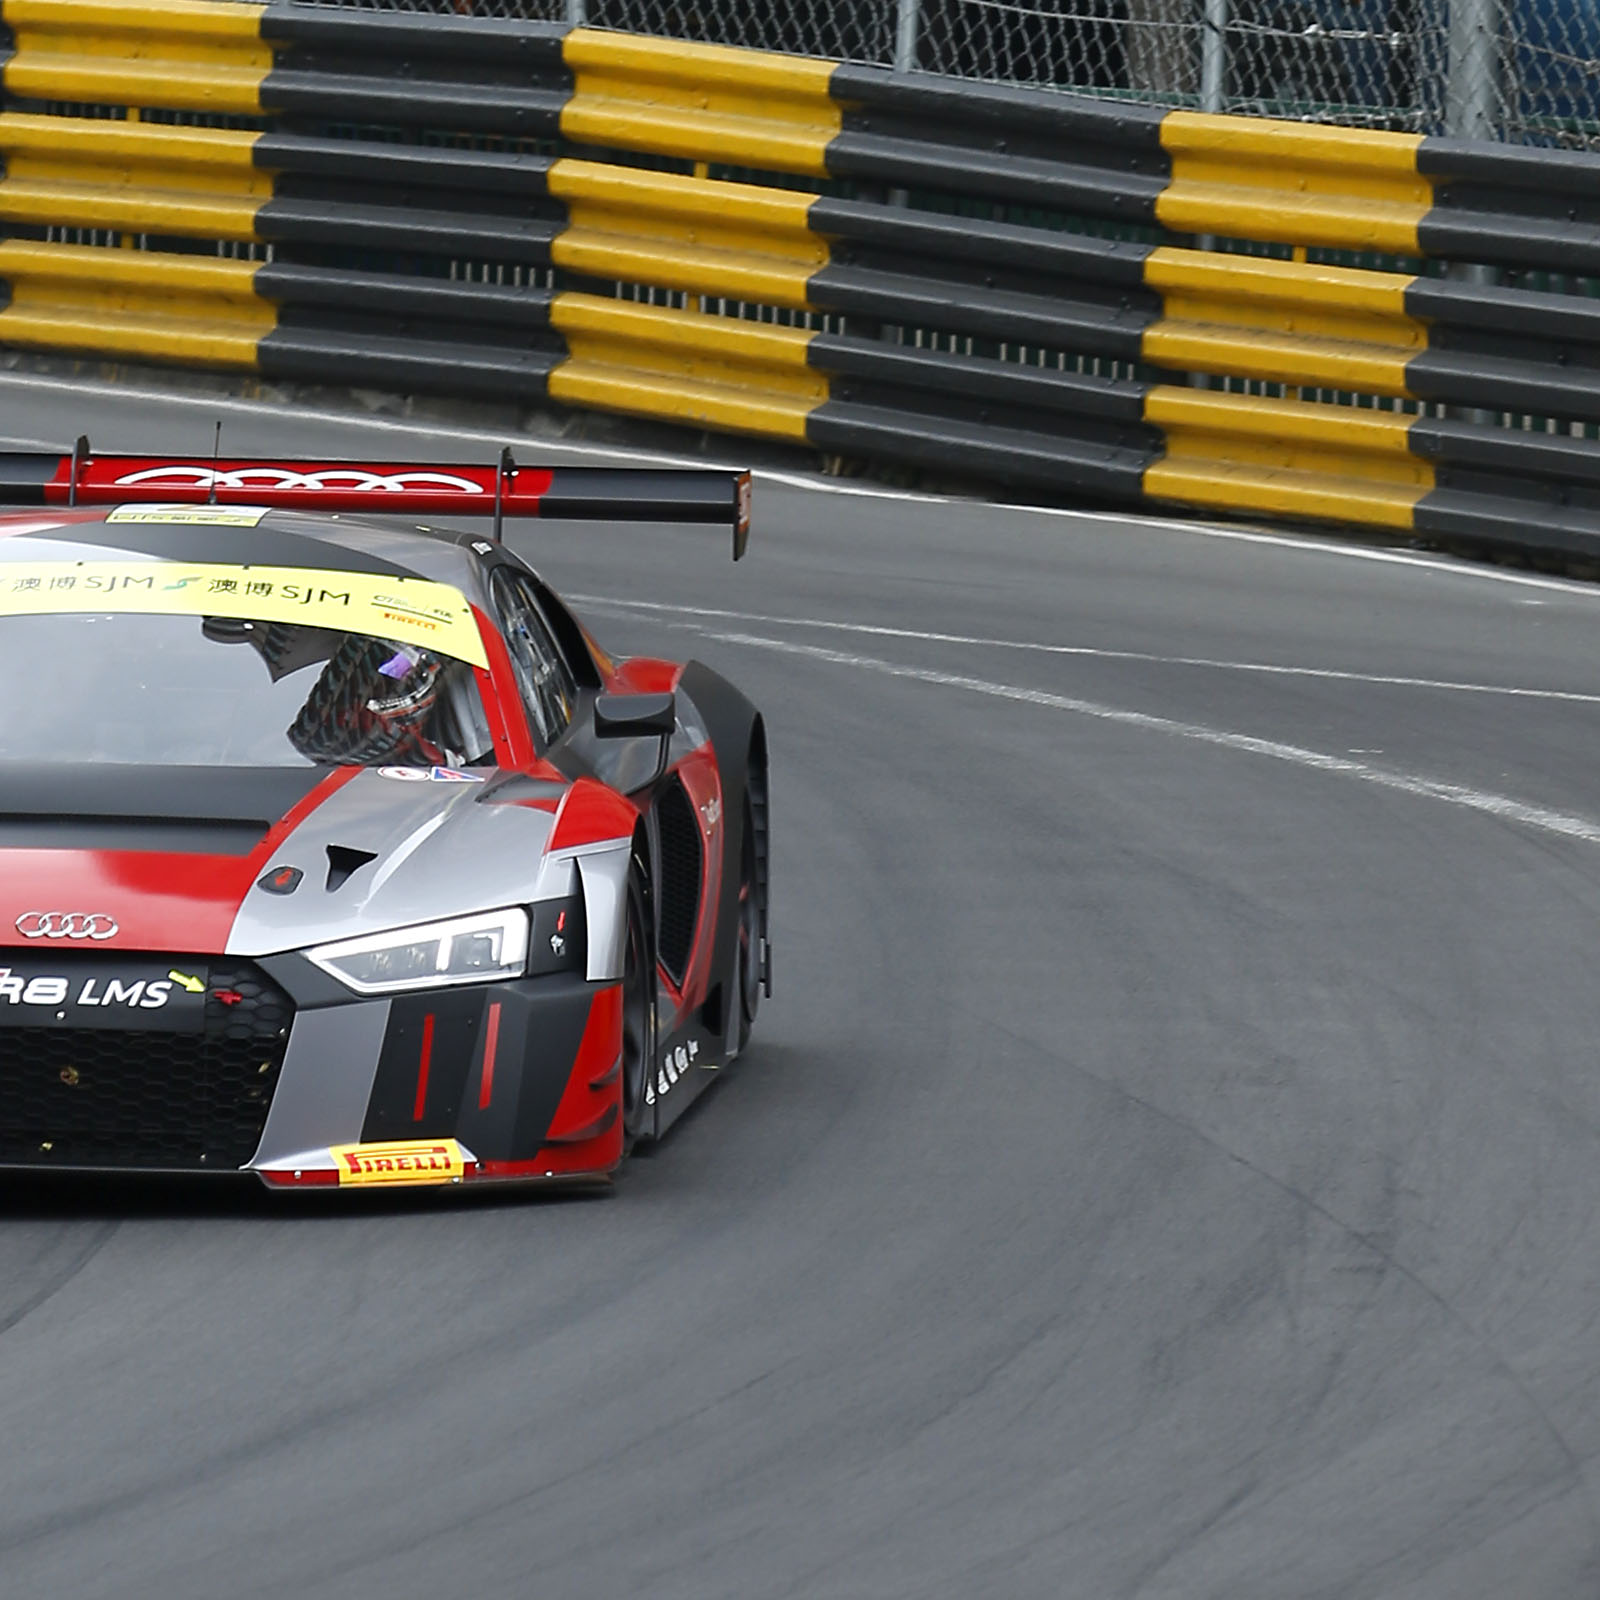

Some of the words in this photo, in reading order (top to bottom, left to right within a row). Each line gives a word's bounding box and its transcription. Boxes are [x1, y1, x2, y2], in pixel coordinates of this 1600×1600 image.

[84, 574, 154, 593] SJM
[207, 578, 274, 596] 澳博
[281, 584, 351, 606] SJM
[77, 978, 173, 1008] LMS
[343, 1146, 452, 1175] PIRELLI
